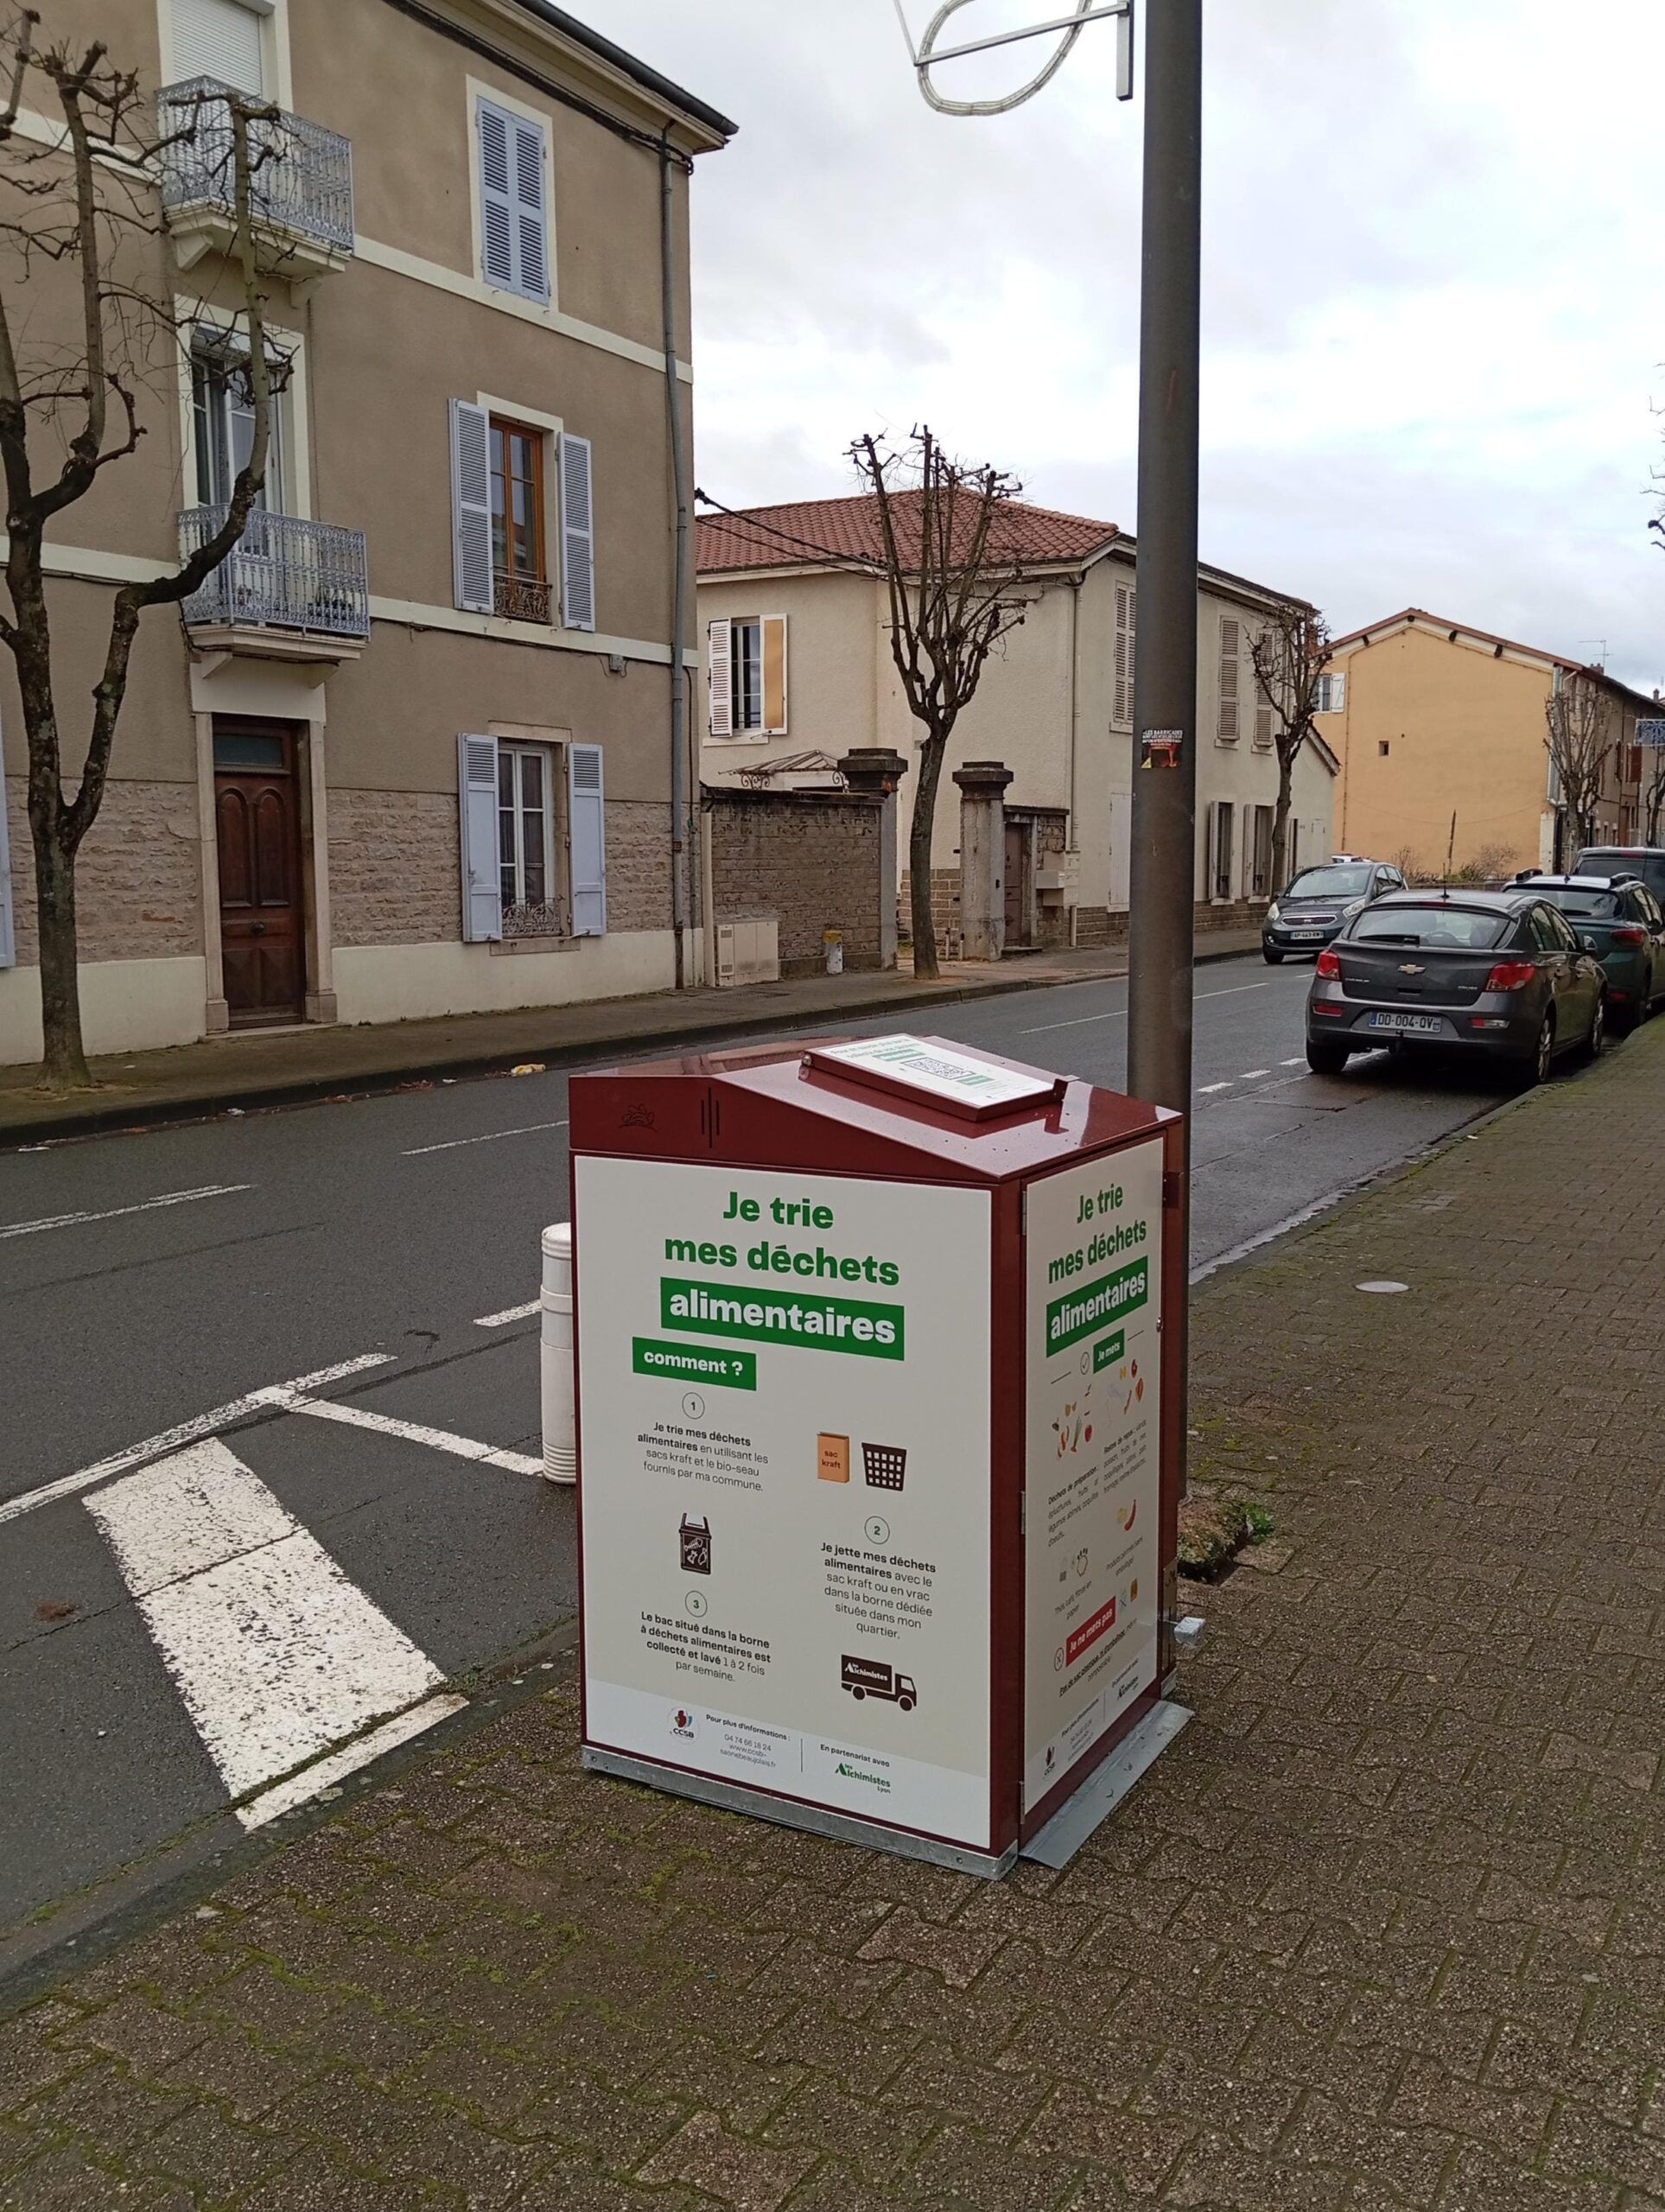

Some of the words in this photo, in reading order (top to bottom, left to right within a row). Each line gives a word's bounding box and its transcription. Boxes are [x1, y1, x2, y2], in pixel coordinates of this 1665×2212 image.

[723, 1191, 760, 1223] Je
[770, 1197, 834, 1230] trie
[1077, 1194, 1094, 1224] Je
[1097, 1183, 1123, 1215] trie
[665, 1237, 737, 1268] mes
[747, 1241, 899, 1286] déchets
[1048, 1249, 1083, 1284] mes
[1088, 1219, 1147, 1266] déchets
[670, 1288, 896, 1344] alimentaires
[1051, 1272, 1146, 1340] alimentaires
[644, 1350, 727, 1375] comment
[732, 1361, 743, 1376] ?
[1097, 1347, 1106, 1363] Je
[1107, 1342, 1121, 1358] mets
[691, 1402, 696, 1411] 1
[638, 1433, 698, 1452] alimentaires
[701, 1446, 712, 1454] en
[715, 1447, 753, 1461] utilisant
[754, 1452, 768, 1464] les
[653, 1422, 664, 1432] Je
[666, 1425, 683, 1435] trie
[686, 1429, 707, 1439] mes
[709, 1431, 751, 1446] déchets
[644, 1460, 676, 1475] fournis
[677, 1468, 693, 1478] par
[696, 1471, 710, 1482] ma
[712, 1475, 764, 1491] commune.
[646, 1449, 668, 1460] sacs
[670, 1452, 692, 1465] kraft
[695, 1457, 704, 1466] et
[707, 1459, 715, 1468] le
[716, 1460, 759, 1477] bio-seau
[822, 1459, 841, 1469] kraft
[874, 1526, 880, 1535] 2
[821, 1542, 832, 1553] Je
[834, 1545, 861, 1559] jette
[863, 1551, 887, 1564] mes
[889, 1555, 936, 1573] déchets
[824, 1558, 892, 1580] alimentaires
[894, 1573, 920, 1585] avec
[923, 1576, 932, 1587] le
[824, 1586, 849, 1599] dans
[852, 1591, 861, 1602] la
[863, 1593, 893, 1608] borne
[896, 1599, 932, 1617] dédiée
[827, 1573, 845, 1584] sac
[848, 1575, 872, 1590] kraft
[875, 1583, 888, 1593] ou
[891, 1586, 904, 1596] en
[906, 1589, 930, 1602] vrac
[693, 1600, 700, 1609] 3
[835, 1603, 867, 1618] située
[869, 1610, 895, 1624] dans
[898, 1617, 921, 1629] mon
[640, 1624, 646, 1634] à
[649, 1626, 689, 1643] déchets
[690, 1637, 753, 1659] alimentaires
[754, 1651, 772, 1663] est
[641, 1611, 652, 1621] Le
[655, 1614, 673, 1626] bac
[675, 1618, 699, 1632] situé
[702, 1625, 726, 1638] dans
[728, 1630, 737, 1641] la
[740, 1632, 770, 1649] borne
[856, 1621, 900, 1639] quartier.
[1070, 1640, 1076, 1654] Je
[1077, 1635, 1084, 1647] ne
[1086, 1618, 1102, 1639] mets
[1102, 1609, 1113, 1627] pas
[646, 1640, 686, 1656] collecté
[688, 1649, 698, 1660] et
[701, 1652, 721, 1665] lavé
[723, 1656, 728, 1667] 1
[730, 1658, 736, 1669] à
[738, 1661, 745, 1671] 2
[747, 1662, 766, 1675] fois
[676, 1661, 691, 1672] par
[693, 1664, 735, 1682] semaine.
[706, 1713, 721, 1723] Pour
[722, 1719, 737, 1728] plus
[831, 1747, 871, 1763] partenariat
